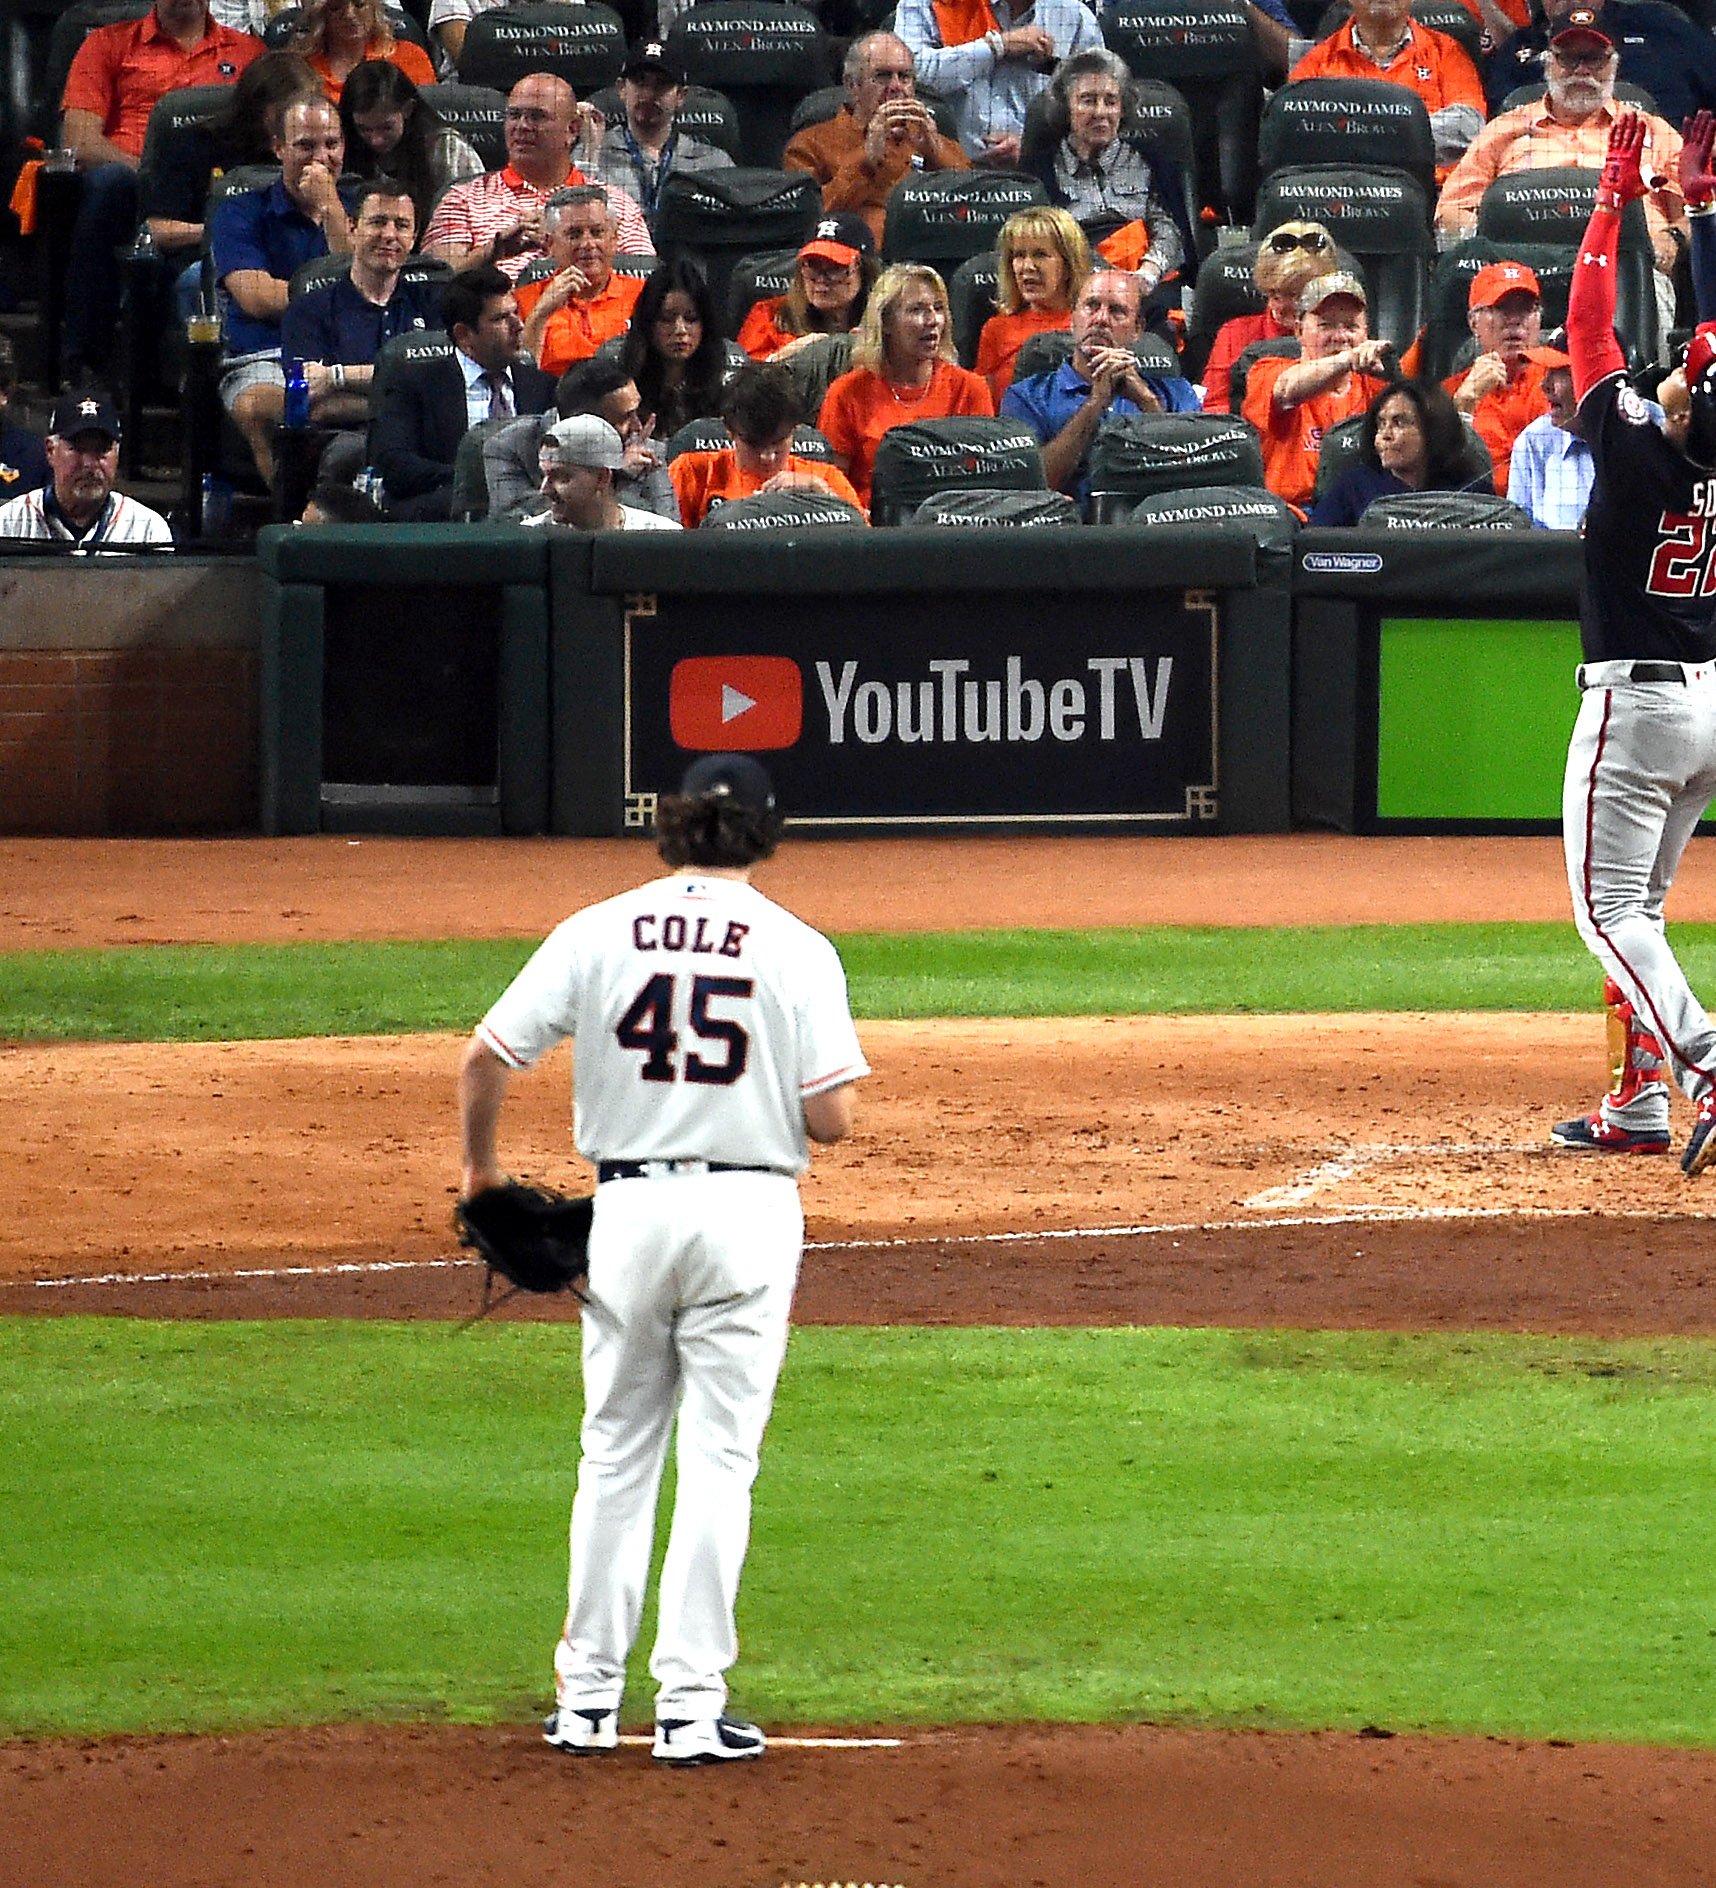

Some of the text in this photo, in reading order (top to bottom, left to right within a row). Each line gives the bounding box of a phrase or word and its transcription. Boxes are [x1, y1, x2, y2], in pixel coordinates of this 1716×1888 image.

[687, 20, 816, 34] RAYMOND JAMES
[1119, 14, 1247, 28] RAYMOND JAMES
[495, 22, 619, 40] RAYMOND JAMES
[557, 41, 610, 56] BROWN
[750, 36, 805, 51] BROWN
[1283, 100, 1412, 116] RAYMOND JAMES
[460, 109, 504, 123] JAME
[904, 189, 1033, 204] RAYMOND JAMES
[1280, 185, 1403, 199] RAYMOND JAMES
[1505, 187, 1581, 203] RAYMOND
[1341, 203, 1392, 218] BROWN
[911, 436, 1035, 458] RAYMOND JAMES
[975, 458, 1028, 474] BROWN
[801, 512, 851, 526] JAMES
[1146, 502, 1278, 526] RAYMOND JAMES
[1310, 556, 1379, 571] Van Wagner
[632, 913, 750, 959] COLE
[616, 972, 757, 1087] 45
